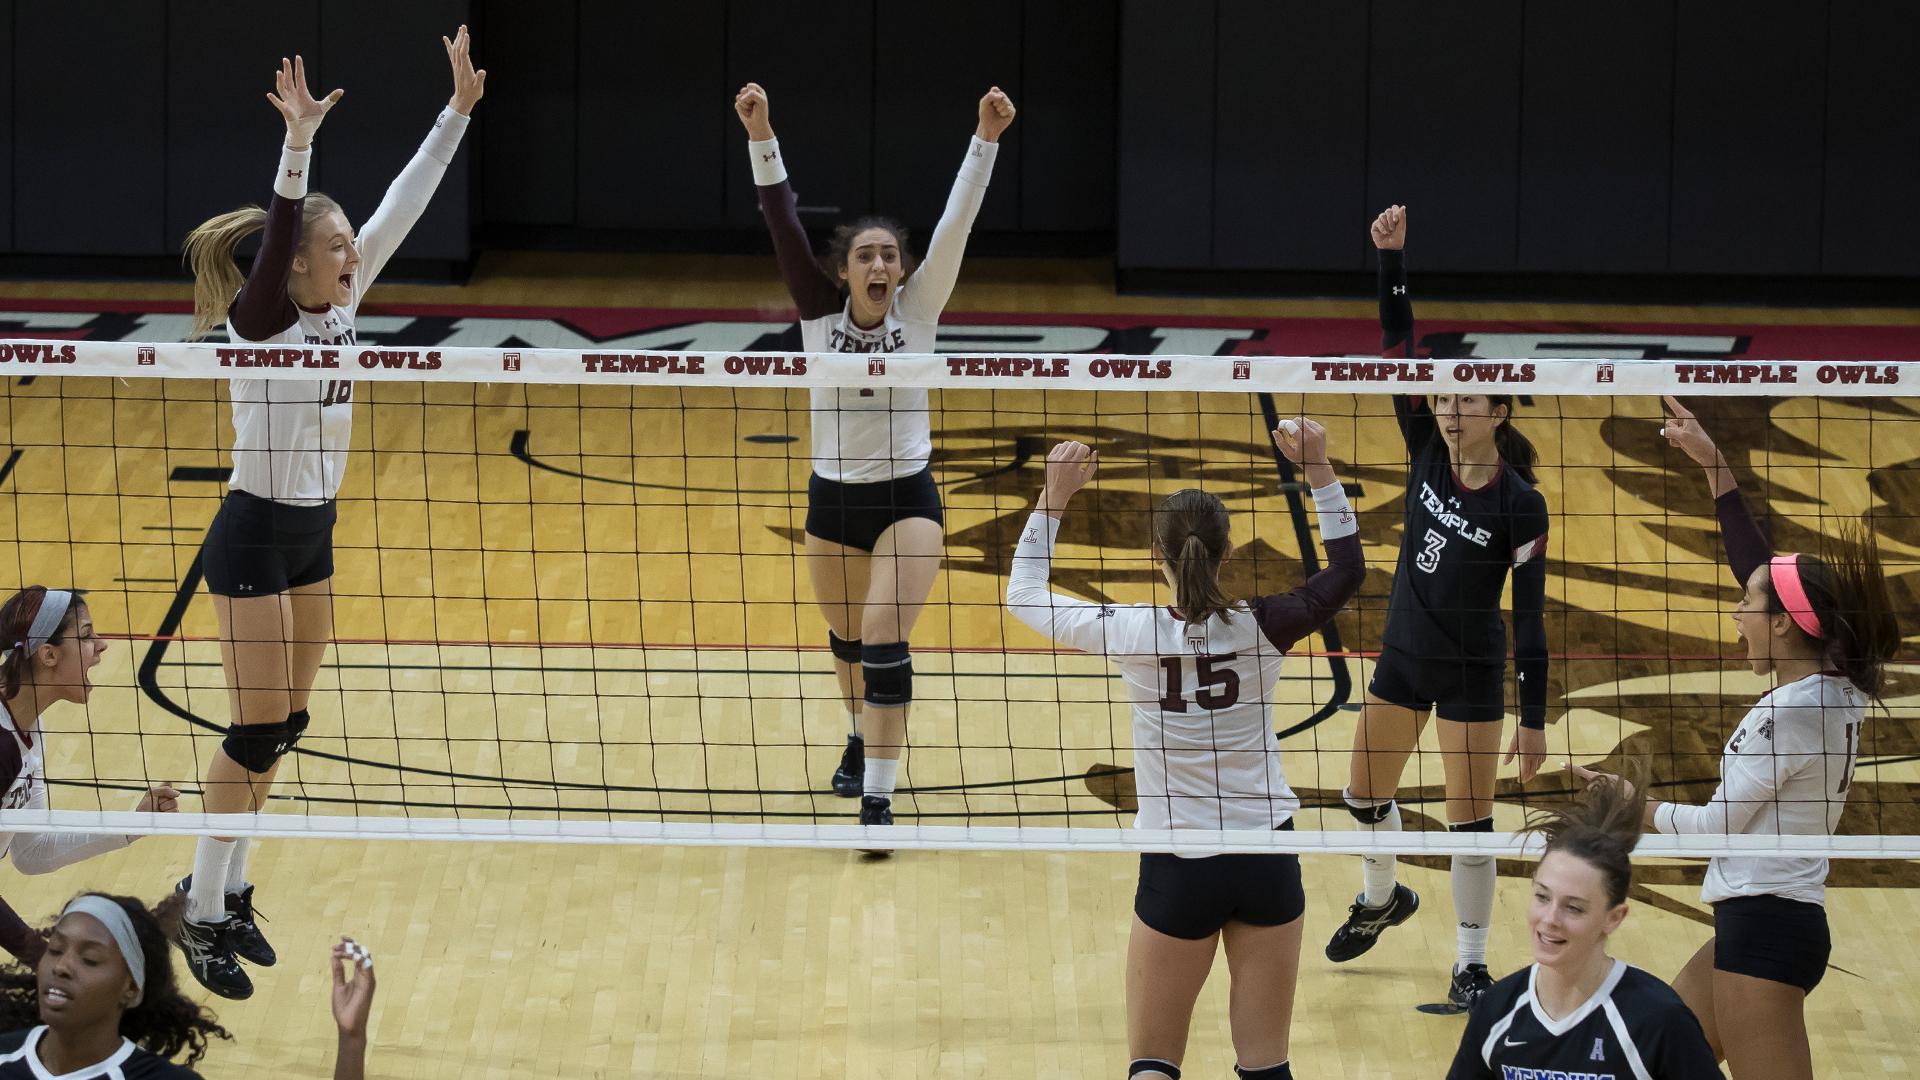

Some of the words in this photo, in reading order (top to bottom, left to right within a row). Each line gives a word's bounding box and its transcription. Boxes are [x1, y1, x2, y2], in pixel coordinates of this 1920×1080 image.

[216, 348, 340, 369] TEMPLE
[358, 350, 442, 370] OWLS
[581, 354, 705, 375] TEMPLE
[723, 356, 807, 376] OWLS
[946, 357, 1070, 378] TEMPLE
[1088, 359, 1172, 379] OWLS
[1311, 362, 1434, 382] TEMPLE
[1452, 363, 1536, 383] OWLS
[1674, 364, 1797, 384] TEMPLE
[1816, 365, 1899, 384] OWLS
[1419, 481, 1492, 547] TEMPLE
[1416, 528, 1448, 574] 3
[1160, 652, 1240, 713] 15
[1837, 720, 1861, 794] 1
[1589, 1037, 1605, 1061] A
